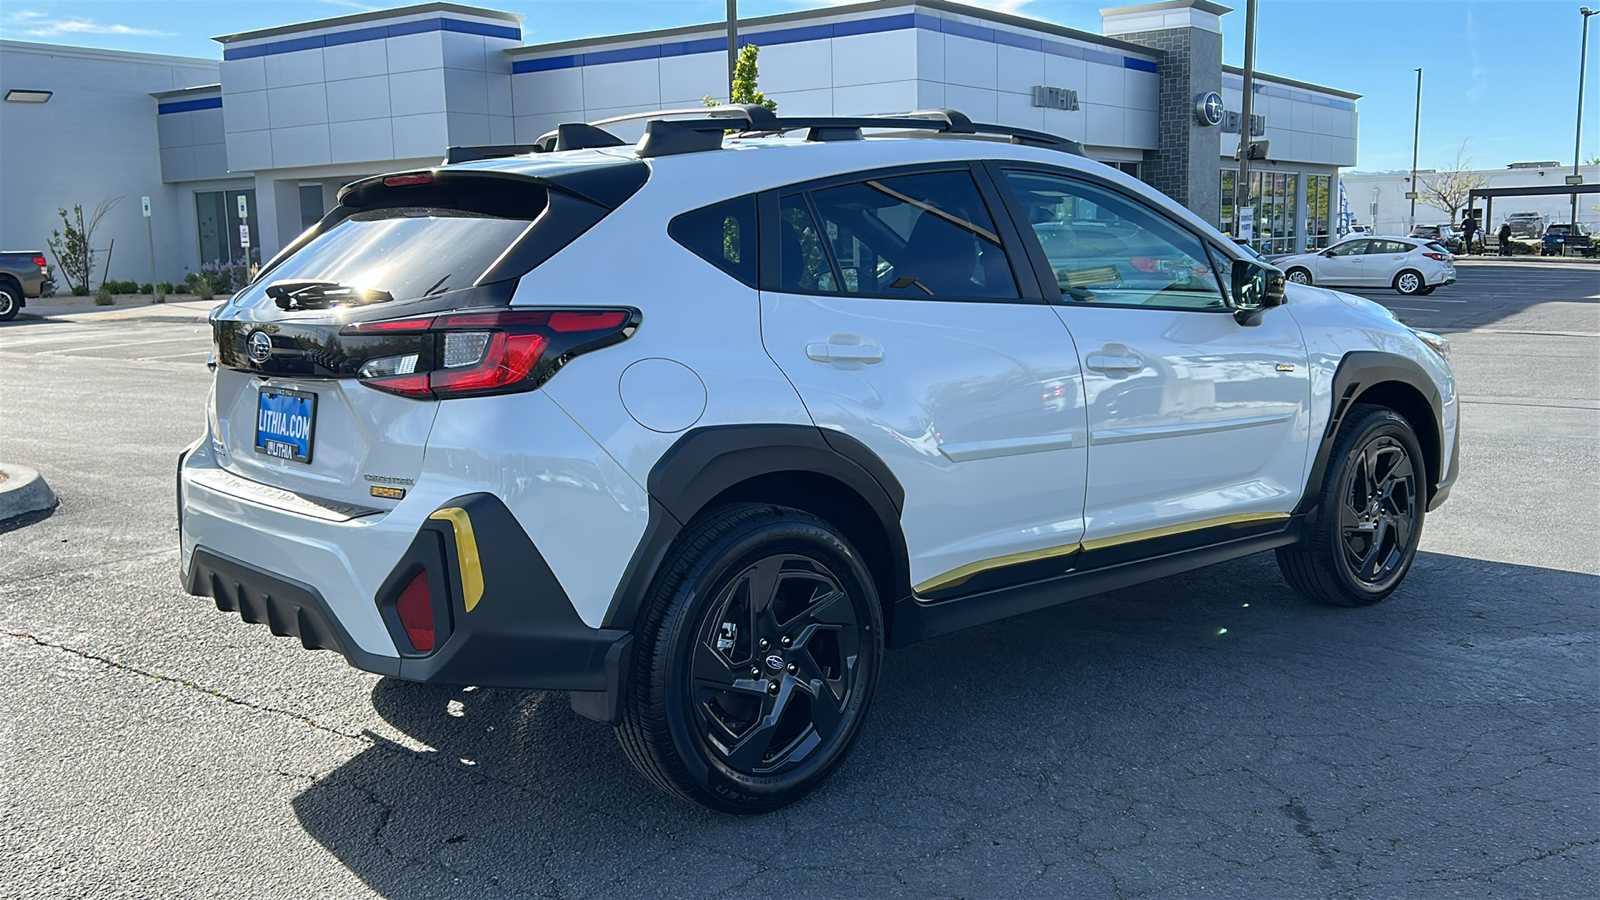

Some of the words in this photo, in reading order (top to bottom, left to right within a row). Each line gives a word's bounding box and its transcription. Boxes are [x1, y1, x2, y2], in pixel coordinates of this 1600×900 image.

[1032, 85, 1080, 111] LITHIA
[258, 408, 311, 440] LITHIA.COM
[273, 442, 293, 460] LITHIA
[371, 486, 401, 497] SPORT
